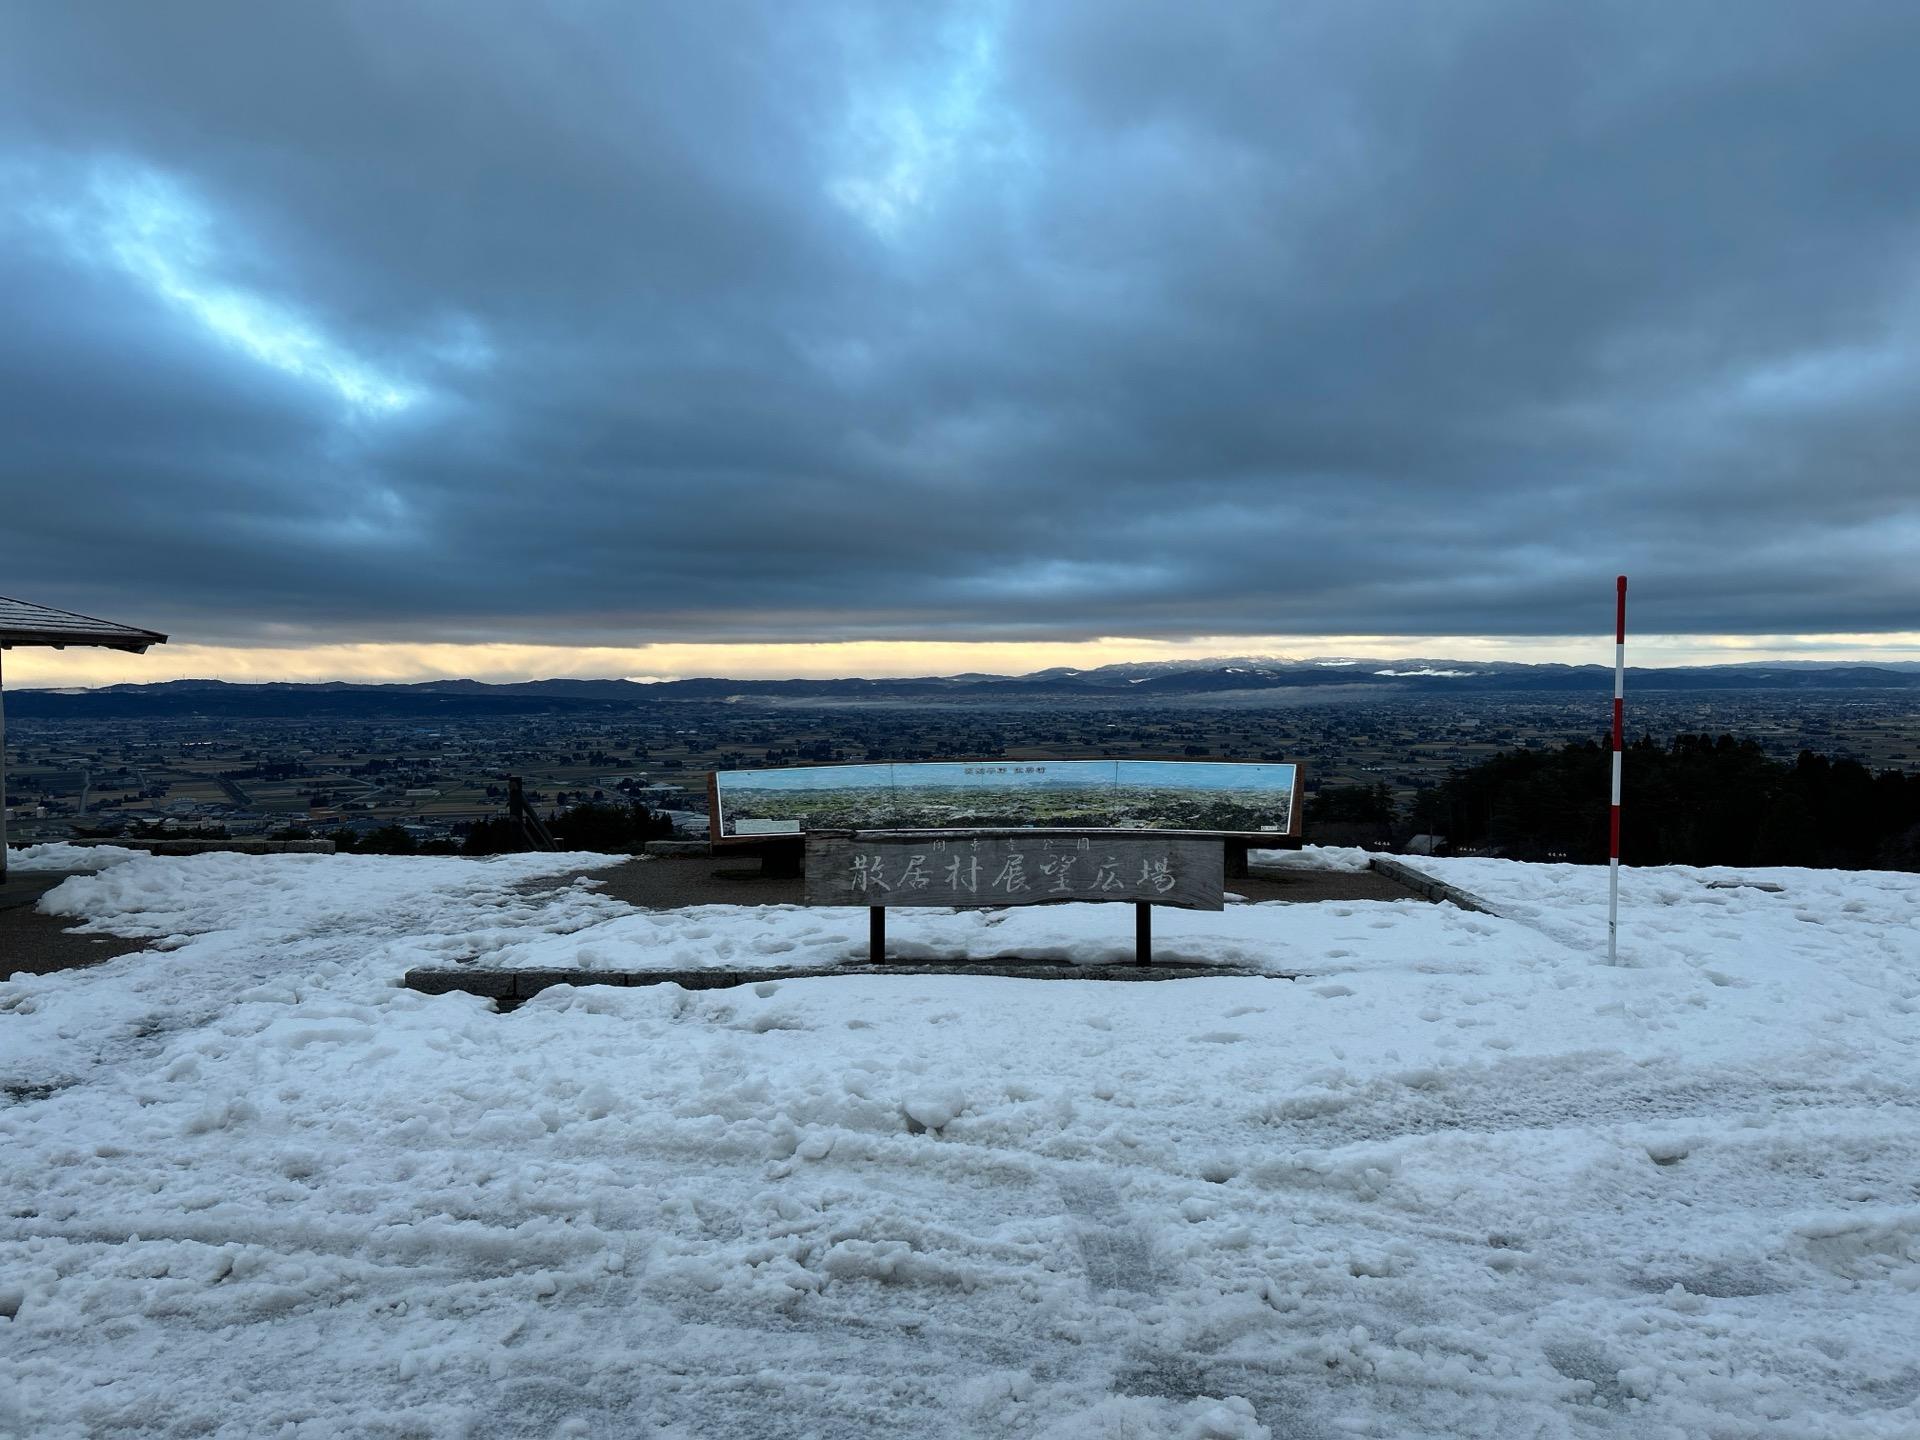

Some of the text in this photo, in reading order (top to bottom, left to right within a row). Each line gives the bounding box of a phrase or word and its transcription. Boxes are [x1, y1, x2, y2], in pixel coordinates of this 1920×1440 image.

[848, 854, 1176, 893] 散居村展望広場
